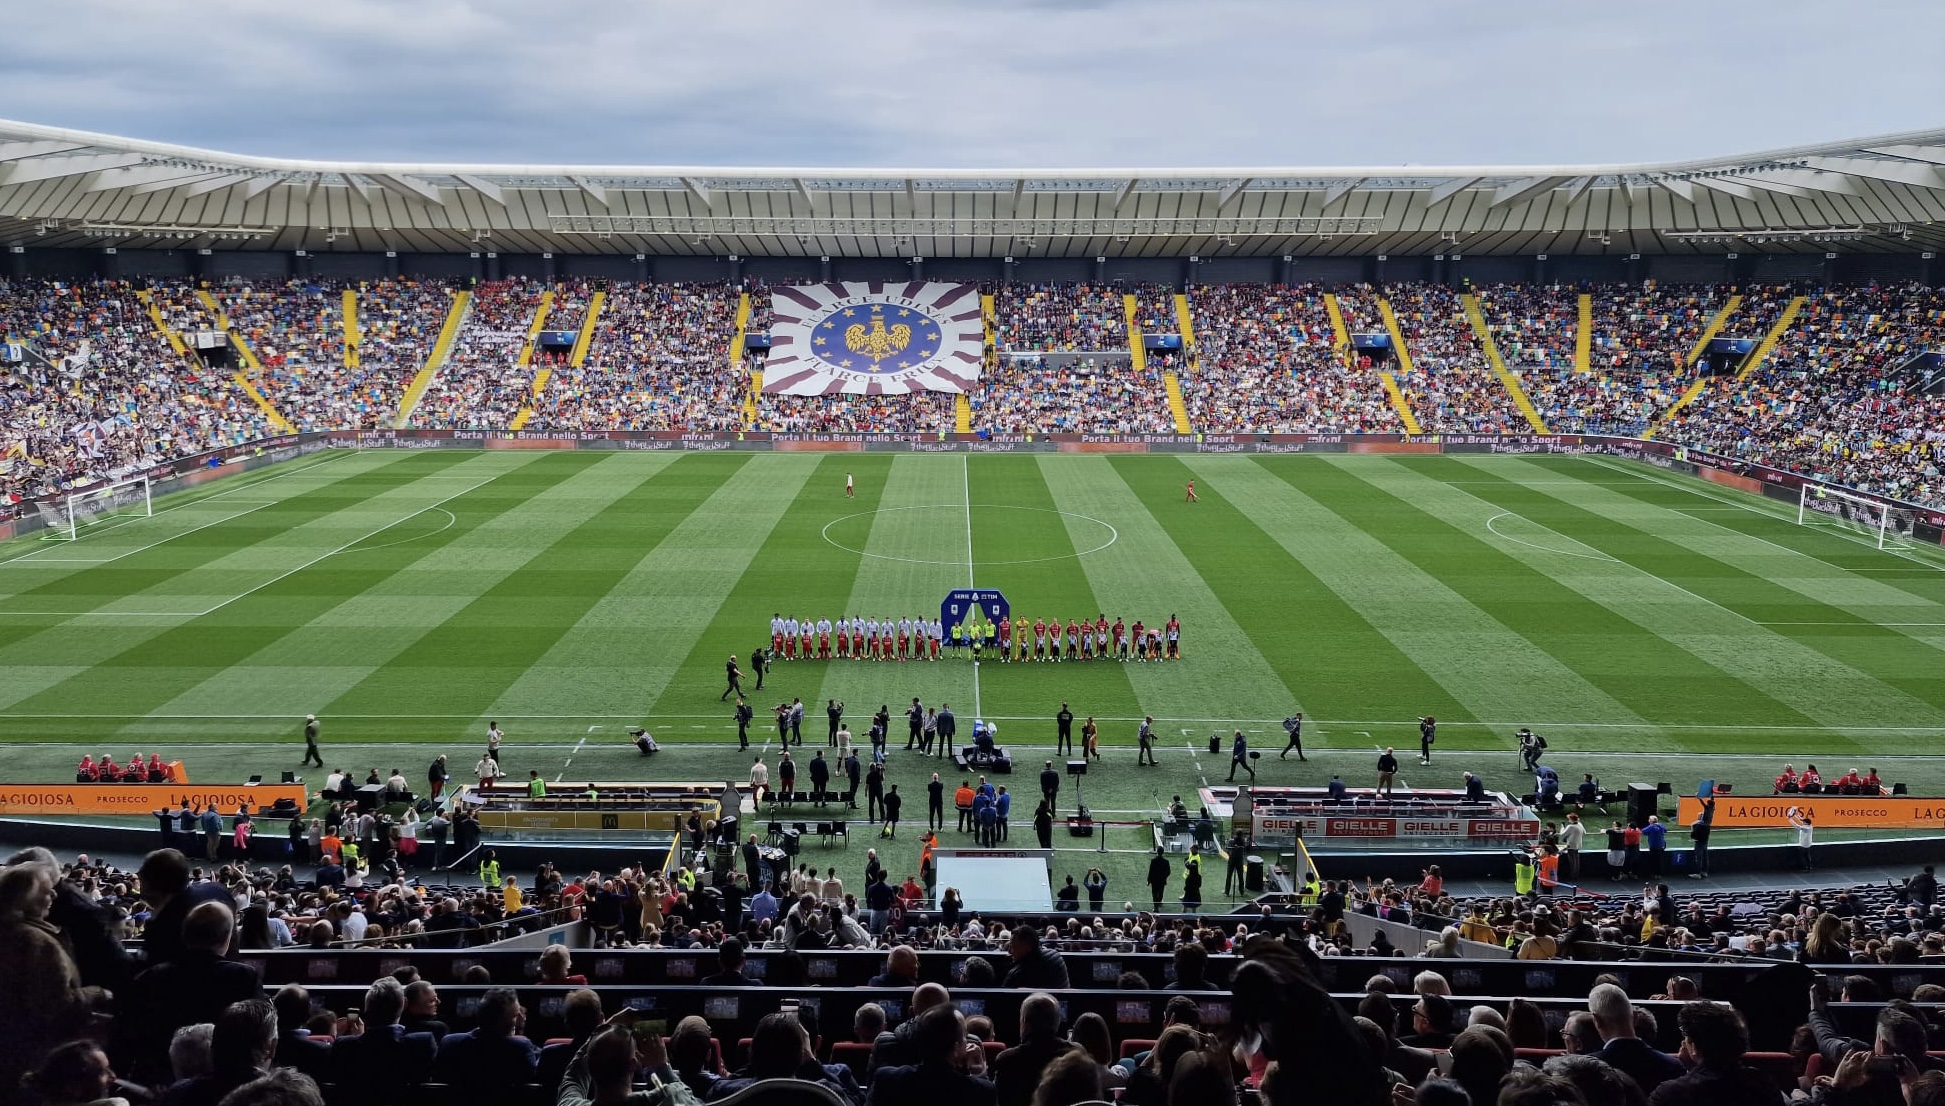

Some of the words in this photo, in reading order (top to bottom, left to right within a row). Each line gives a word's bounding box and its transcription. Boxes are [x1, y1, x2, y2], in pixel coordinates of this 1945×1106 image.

[804, 356, 881, 383] FUARCE
[454, 431, 483, 439] Porta
[487, 431, 492, 439] il
[518, 431, 549, 439] Brand
[553, 432, 577, 440] nello
[771, 433, 800, 441] Porta
[803, 433, 809, 441] il
[833, 433, 863, 441] Brand
[1124, 435, 1140, 443] tuo
[1144, 435, 1174, 443] Brand
[1468, 435, 1498, 443] Brand
[1834, 809, 1888, 817] PROSECCO
[1333, 821, 1388, 830] GIELLE
[1404, 822, 1459, 831] GIELLE
[1475, 823, 1531, 832] GIELLE
